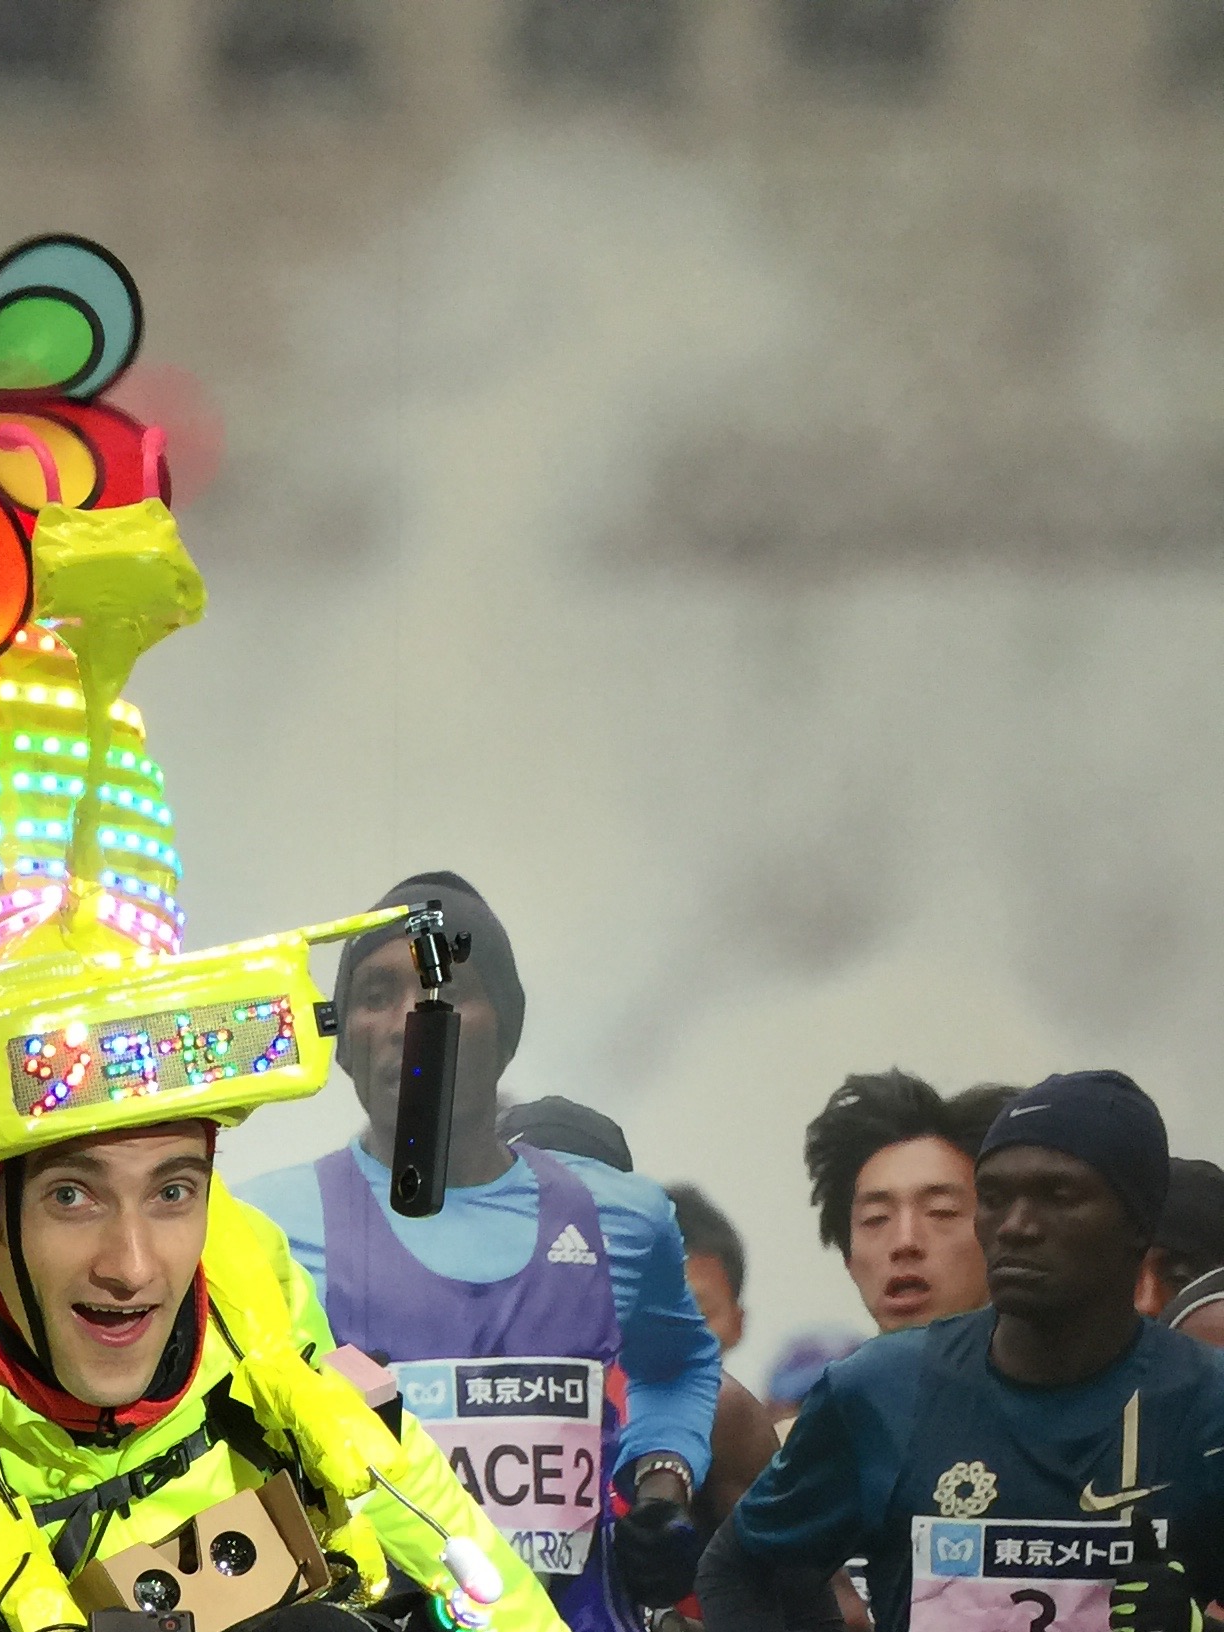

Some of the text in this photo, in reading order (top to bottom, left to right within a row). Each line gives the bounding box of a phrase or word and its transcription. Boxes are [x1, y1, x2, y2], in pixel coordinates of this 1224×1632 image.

[465, 1377, 584, 1405] 東京メトロ
[449, 1444, 595, 1508] ACE 2
[993, 1539, 1135, 1566] 東京メトロ
